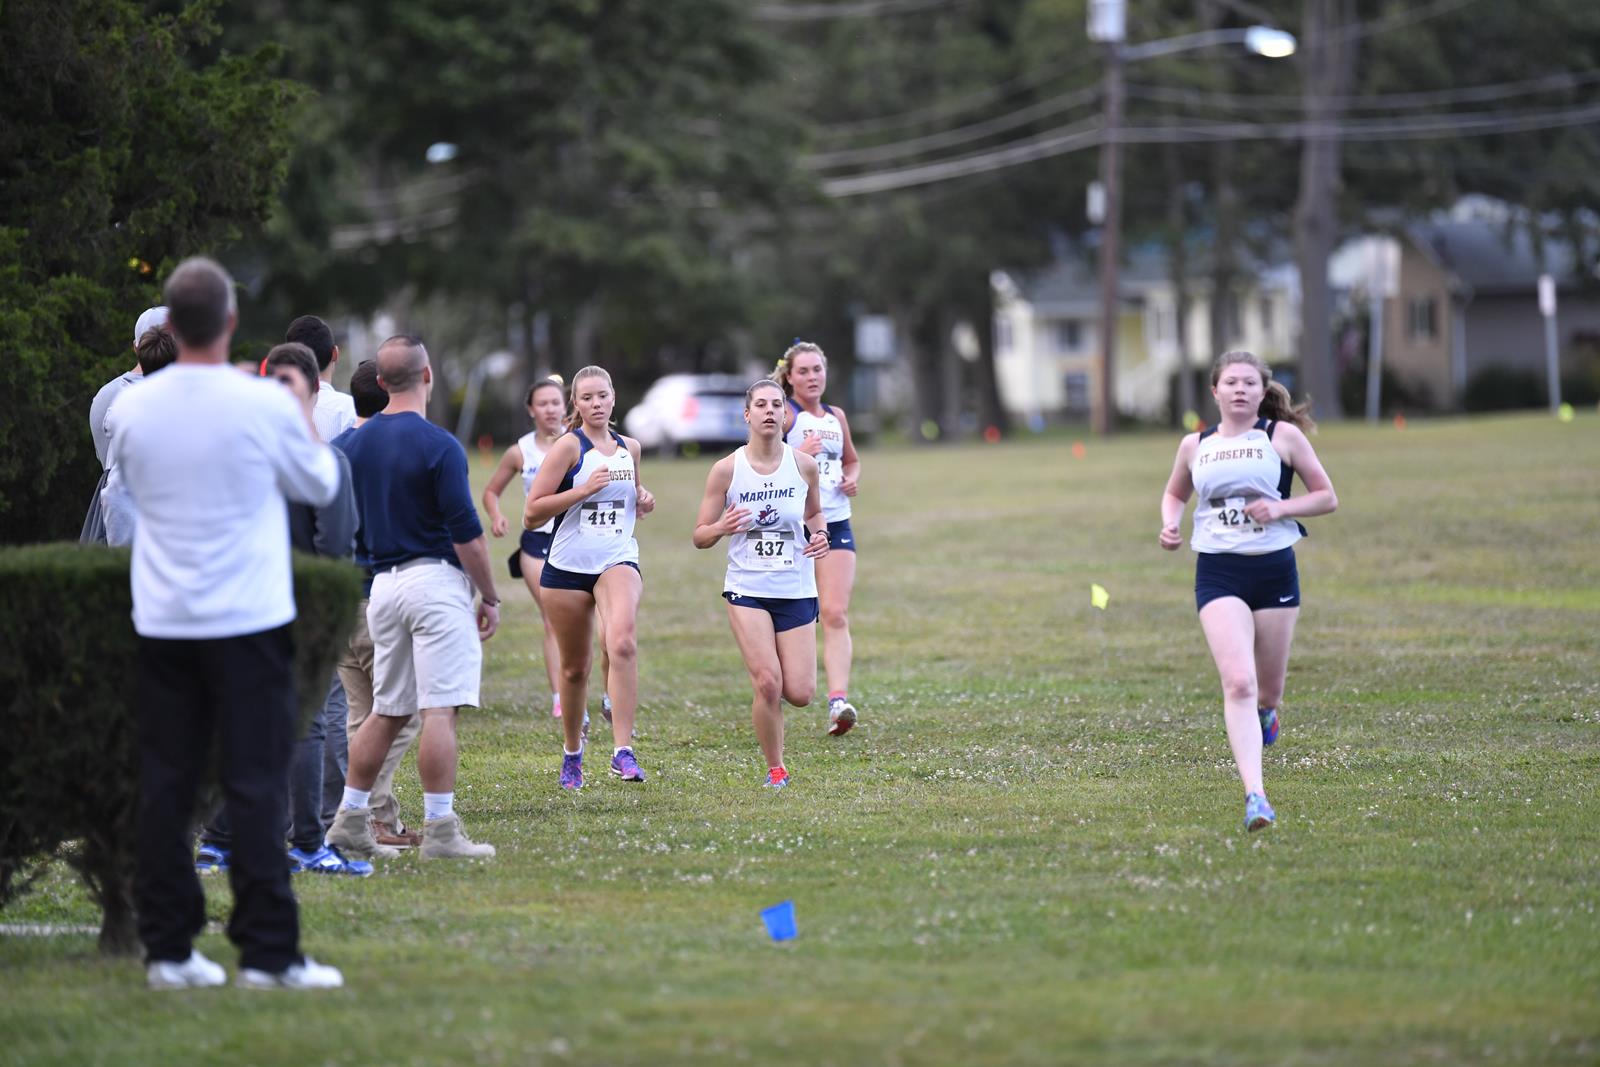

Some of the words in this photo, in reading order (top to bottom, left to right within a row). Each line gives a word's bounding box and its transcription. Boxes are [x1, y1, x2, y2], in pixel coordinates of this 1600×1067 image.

[817, 461, 830, 475] 12
[739, 487, 796, 503] MARITIME
[588, 511, 617, 525] 414
[754, 541, 785, 556] 437
